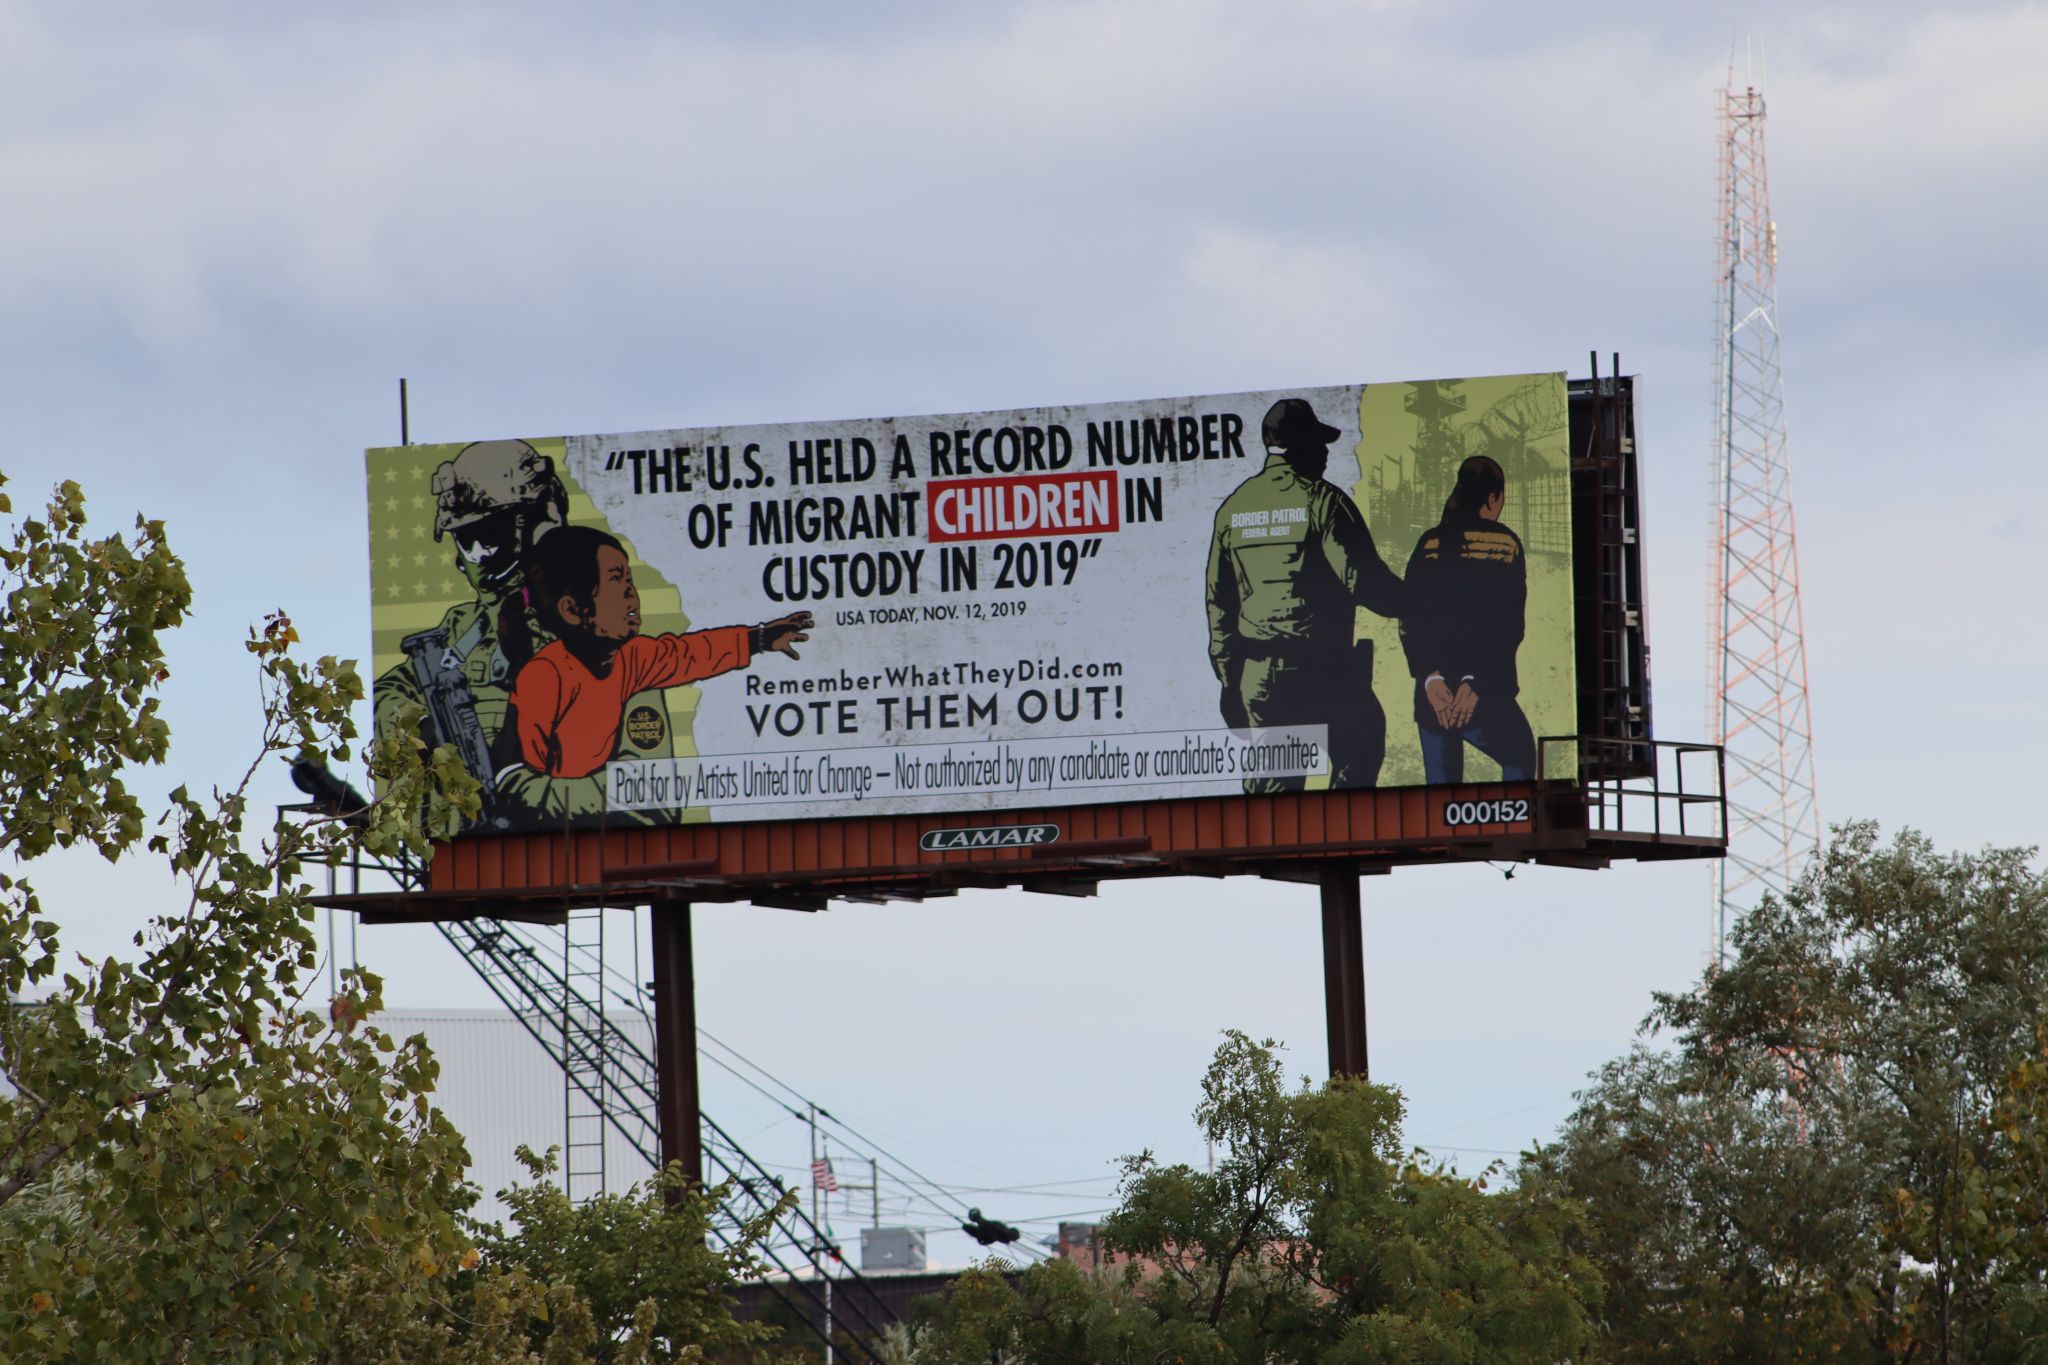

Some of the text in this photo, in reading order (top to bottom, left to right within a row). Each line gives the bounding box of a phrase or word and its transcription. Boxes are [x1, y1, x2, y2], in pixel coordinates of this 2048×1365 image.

[706, 443, 775, 491] U.S.
[789, 437, 876, 485] HELD
[890, 434, 916, 479] A
[929, 424, 1072, 477] RECORD
[1087, 413, 1245, 467] NUMBER
[688, 476, 1163, 549] OF MIGRANT CHILDREN IN
[1231, 507, 1307, 528] BORDER PATROL
[1242, 526, 1290, 538] FEDERAL AGENT
[762, 549, 925, 602] CUSTODY
[940, 546, 977, 592] IN
[836, 601, 1026, 626] USA TODAY, NOV. 12, 2019
[746, 657, 1123, 696] RememberWhatTheyDid.com
[745, 685, 1123, 737] VOTE THEM OUT!
[629, 721, 660, 730] BORDER
[631, 730, 661, 740] PATROL
[616, 762, 645, 804] Paid
[649, 761, 671, 802] for
[675, 762, 691, 809] by
[696, 763, 738, 800] Artists
[743, 756, 789, 798] United
[793, 756, 813, 795] for
[818, 754, 871, 800] Change
[895, 752, 921, 790] Not
[925, 745, 1000, 788] authorized
[1006, 745, 1023, 792] by
[1028, 755, 1055, 790] any
[1060, 740, 1129, 781] candidate
[1134, 750, 1149, 778] or
[1240, 735, 1318, 772] committee
[1446, 800, 1528, 825] 000152
[931, 827, 1045, 848] LAMAR
